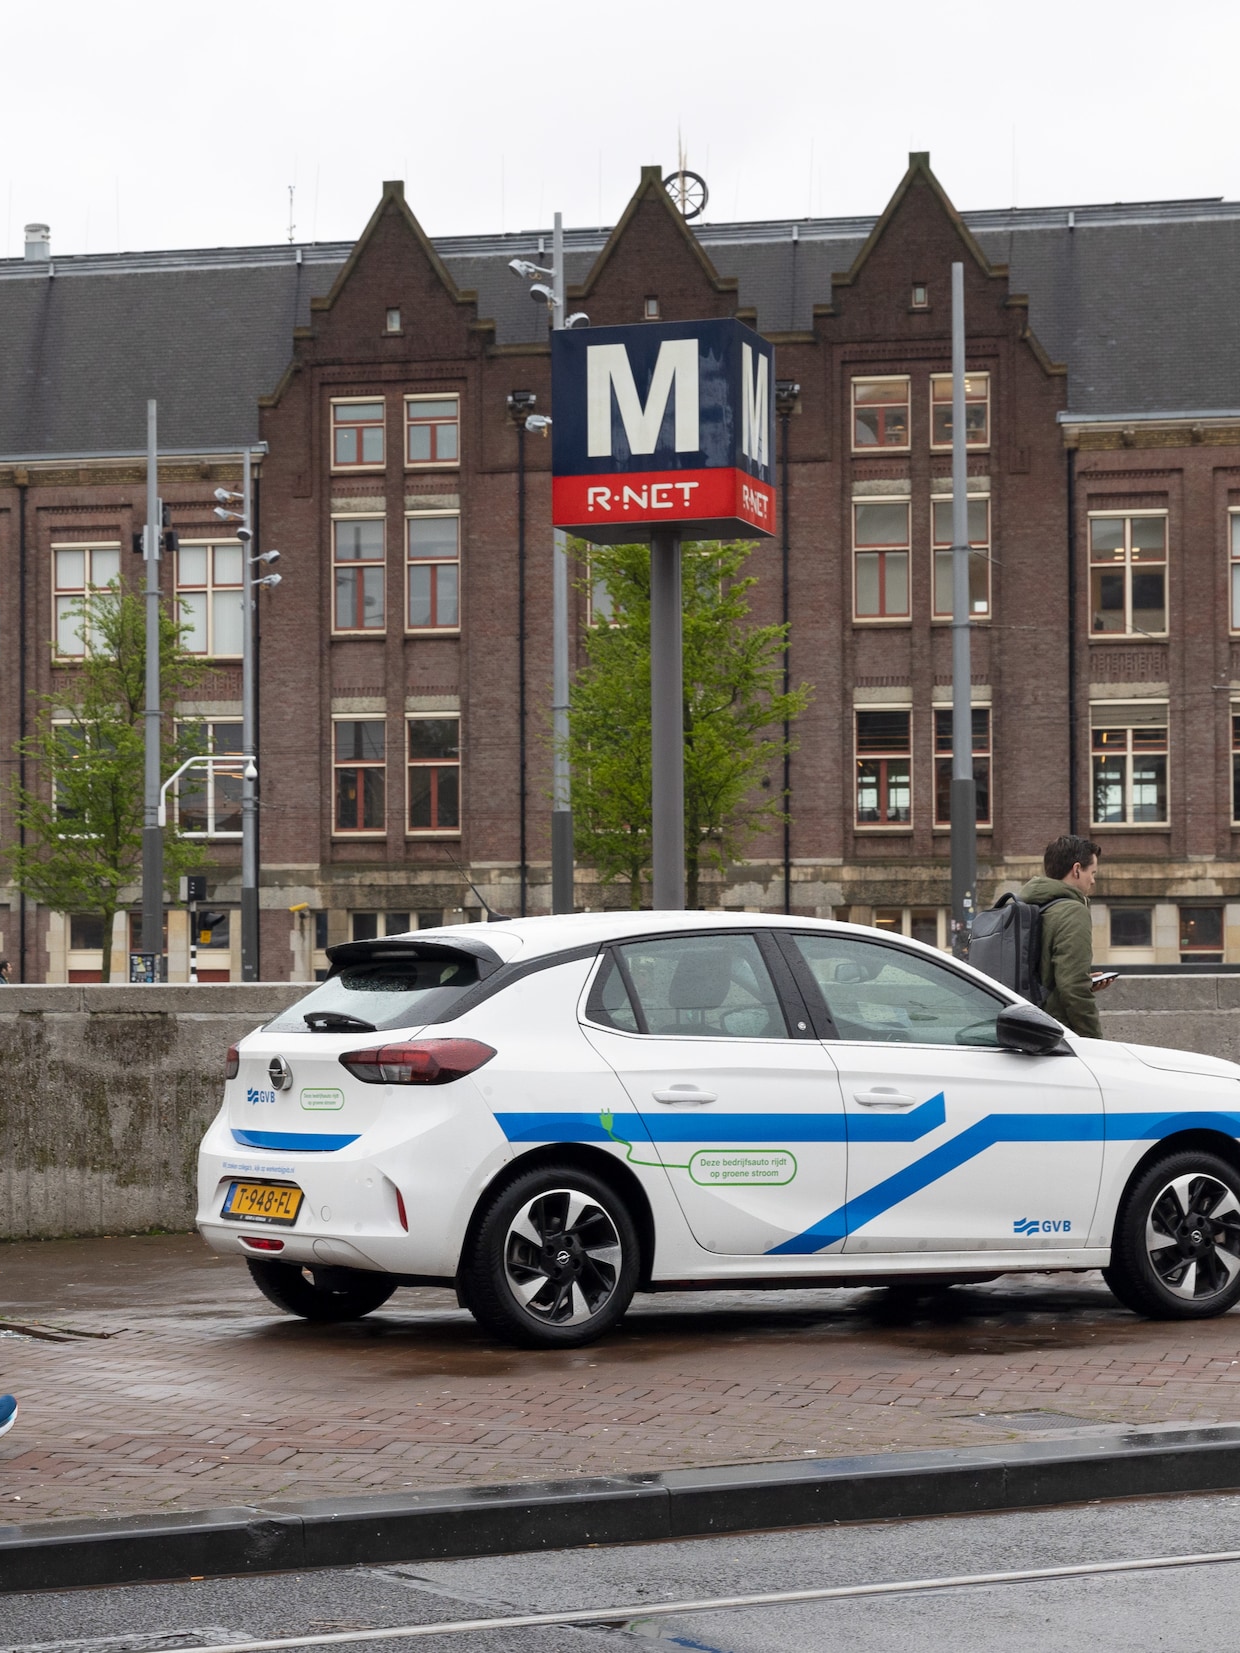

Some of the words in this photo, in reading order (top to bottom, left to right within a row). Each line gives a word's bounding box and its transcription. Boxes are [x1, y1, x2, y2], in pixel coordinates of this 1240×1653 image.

[587, 338, 700, 458] M
[742, 341, 769, 468] M
[260, 1090, 276, 1103] GVB
[700, 1158, 721, 1167] Deze
[722, 1157, 770, 1168] bedrijfsauto
[771, 1157, 787, 1168] rijdt
[710, 1171, 720, 1179] op
[722, 1171, 750, 1180] groene
[751, 1169, 779, 1177] stroom
[237, 1188, 292, 1214] T-948-FL
[1041, 1220, 1072, 1233] GVB
